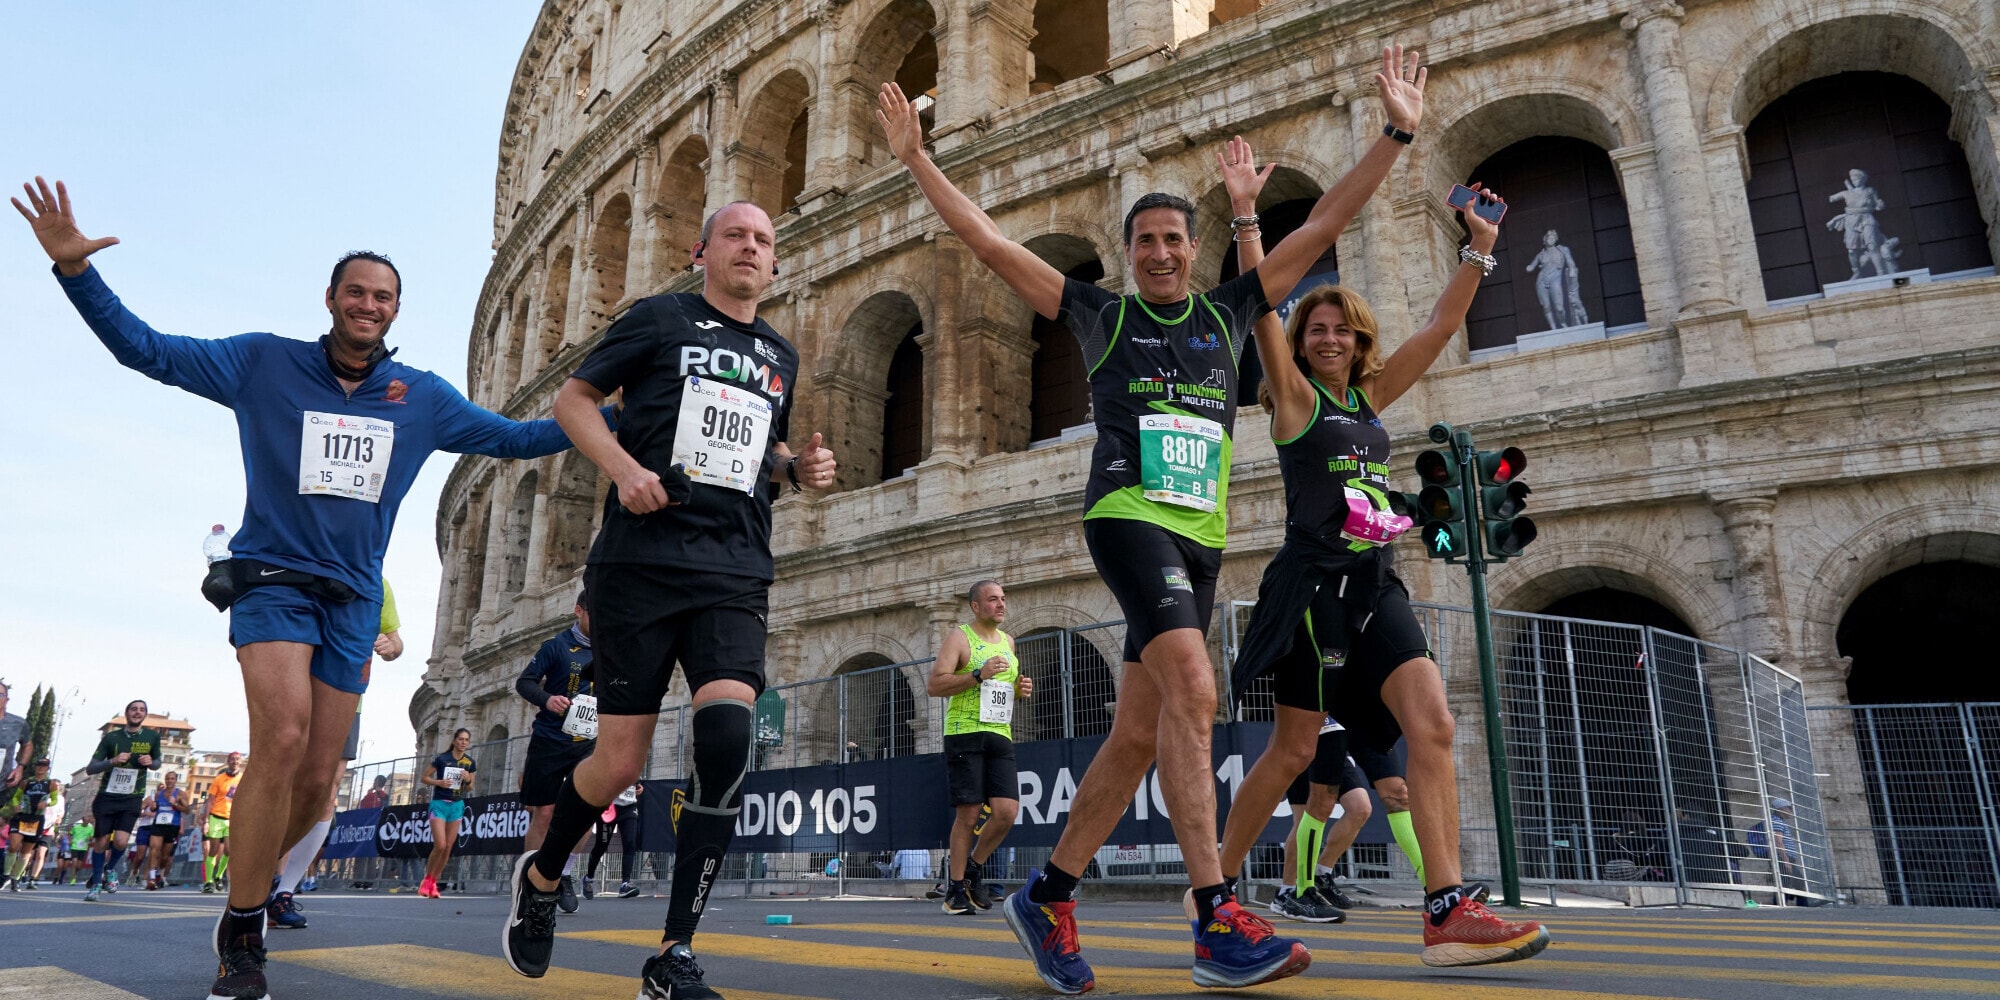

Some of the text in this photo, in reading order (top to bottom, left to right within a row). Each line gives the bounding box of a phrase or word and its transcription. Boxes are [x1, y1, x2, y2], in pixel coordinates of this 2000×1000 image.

[1128, 381, 1227, 401] ROAD RUNNING
[1181, 395, 1225, 411] MOLFETTA
[701, 405, 753, 446] 9186
[323, 433, 374, 463] 11713
[707, 439, 736, 452] GEORGE
[1162, 435, 1207, 469] 8810
[330, 460, 357, 469] MICHAEL
[694, 451, 708, 468] 12
[731, 459, 744, 474] D
[1327, 459, 1390, 477] ROAD RUNN
[319, 470, 333, 483] 15
[353, 475, 365, 487] D
[1161, 475, 1175, 490] 12
[1192, 481, 1202, 495] B
[1363, 527, 1371, 536] 2
[991, 690, 1007, 706] 368
[735, 789, 802, 836] DIO
[809, 785, 877, 835] 105
[401, 819, 434, 844] cisa
[1114, 851, 1143, 861] AN 534
[692, 857, 716, 914] SKINS
[1429, 891, 1461, 915] en
